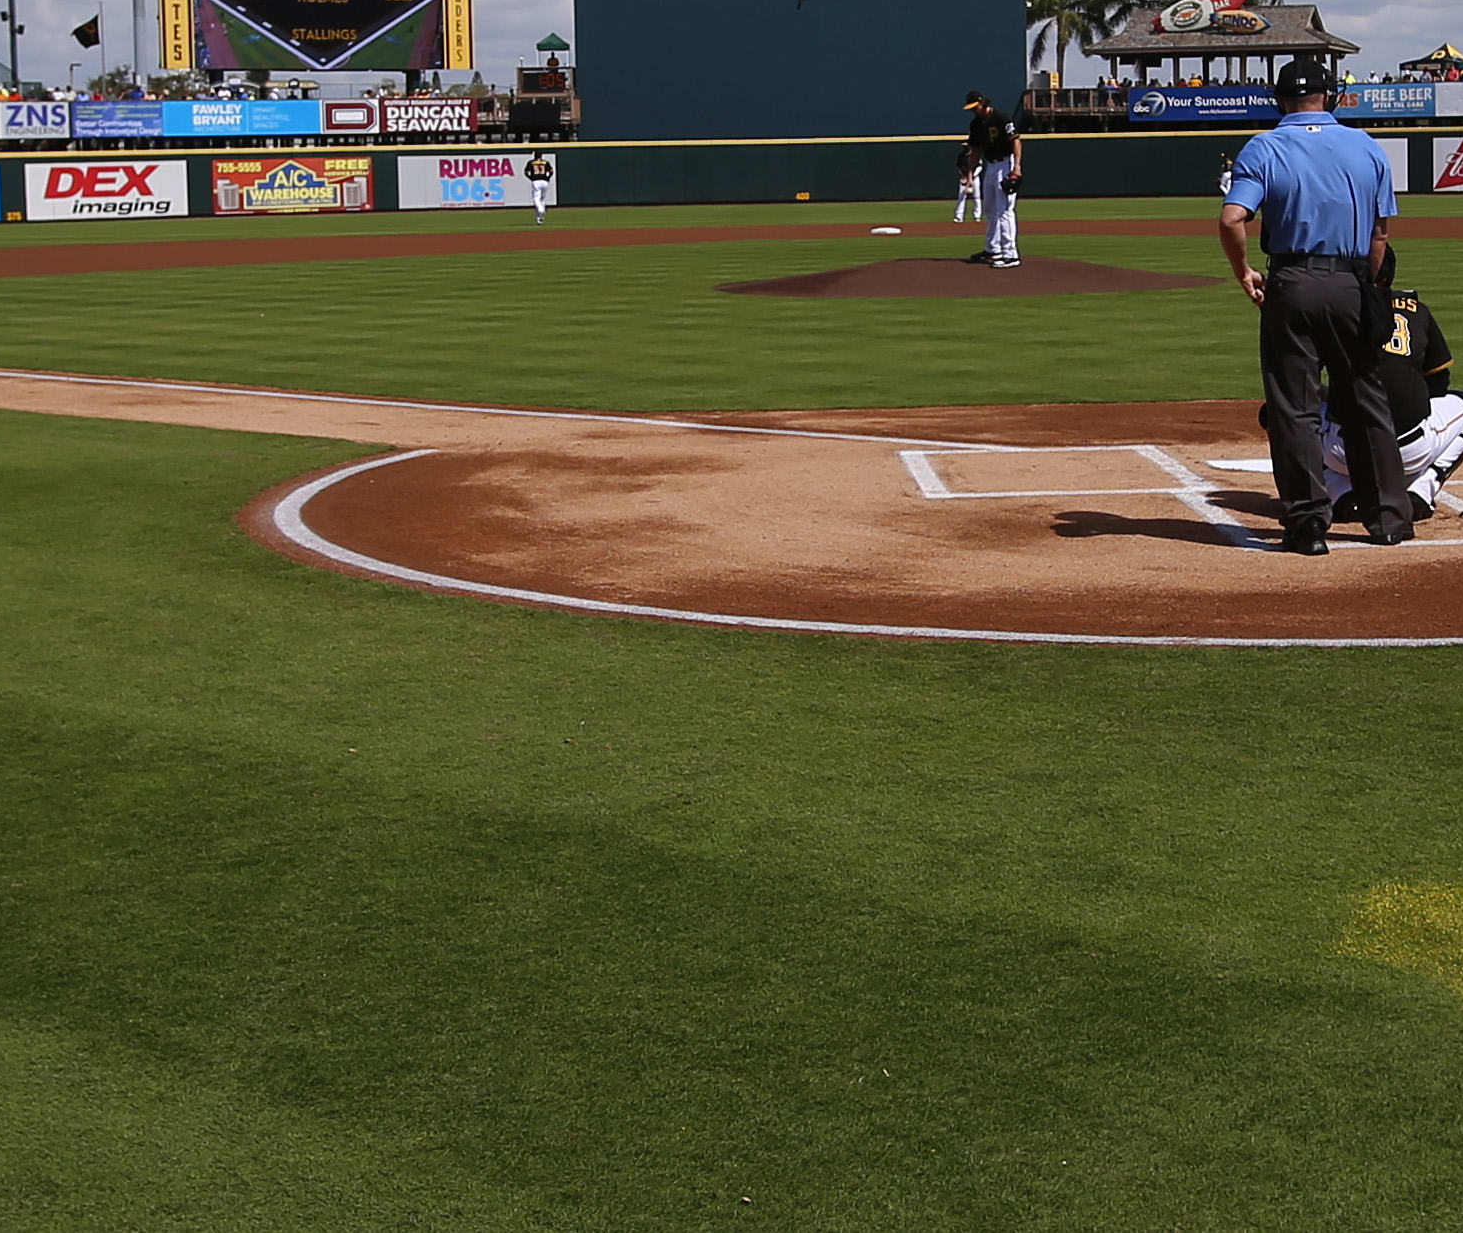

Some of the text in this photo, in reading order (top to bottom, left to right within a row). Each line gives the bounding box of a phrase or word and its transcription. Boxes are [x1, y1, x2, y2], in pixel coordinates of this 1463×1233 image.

[292, 28, 357, 41] STALLINGS
[1166, 96, 1191, 107] Your
[1194, 95, 1246, 107] Suncoast
[1363, 88, 1396, 102] FREE
[1399, 87, 1432, 101] BEER
[192, 104, 242, 114] FAWLEY
[386, 106, 470, 119] DUNCAN
[1133, 101, 1150, 113] abc
[6, 104, 66, 126] ZNS
[193, 115, 242, 125] BRYANT
[5, 126, 65, 135] ENGINEERING
[386, 119, 471, 131] SEAWALL
[216, 161, 262, 173] 755-5555
[323, 159, 369, 170] FREE
[439, 157, 515, 179] RUMBA
[44, 165, 159, 199] DEX
[274, 169, 308, 187] A/C
[249, 187, 334, 201] WAREHOUSE
[72, 199, 172, 215] imaging
